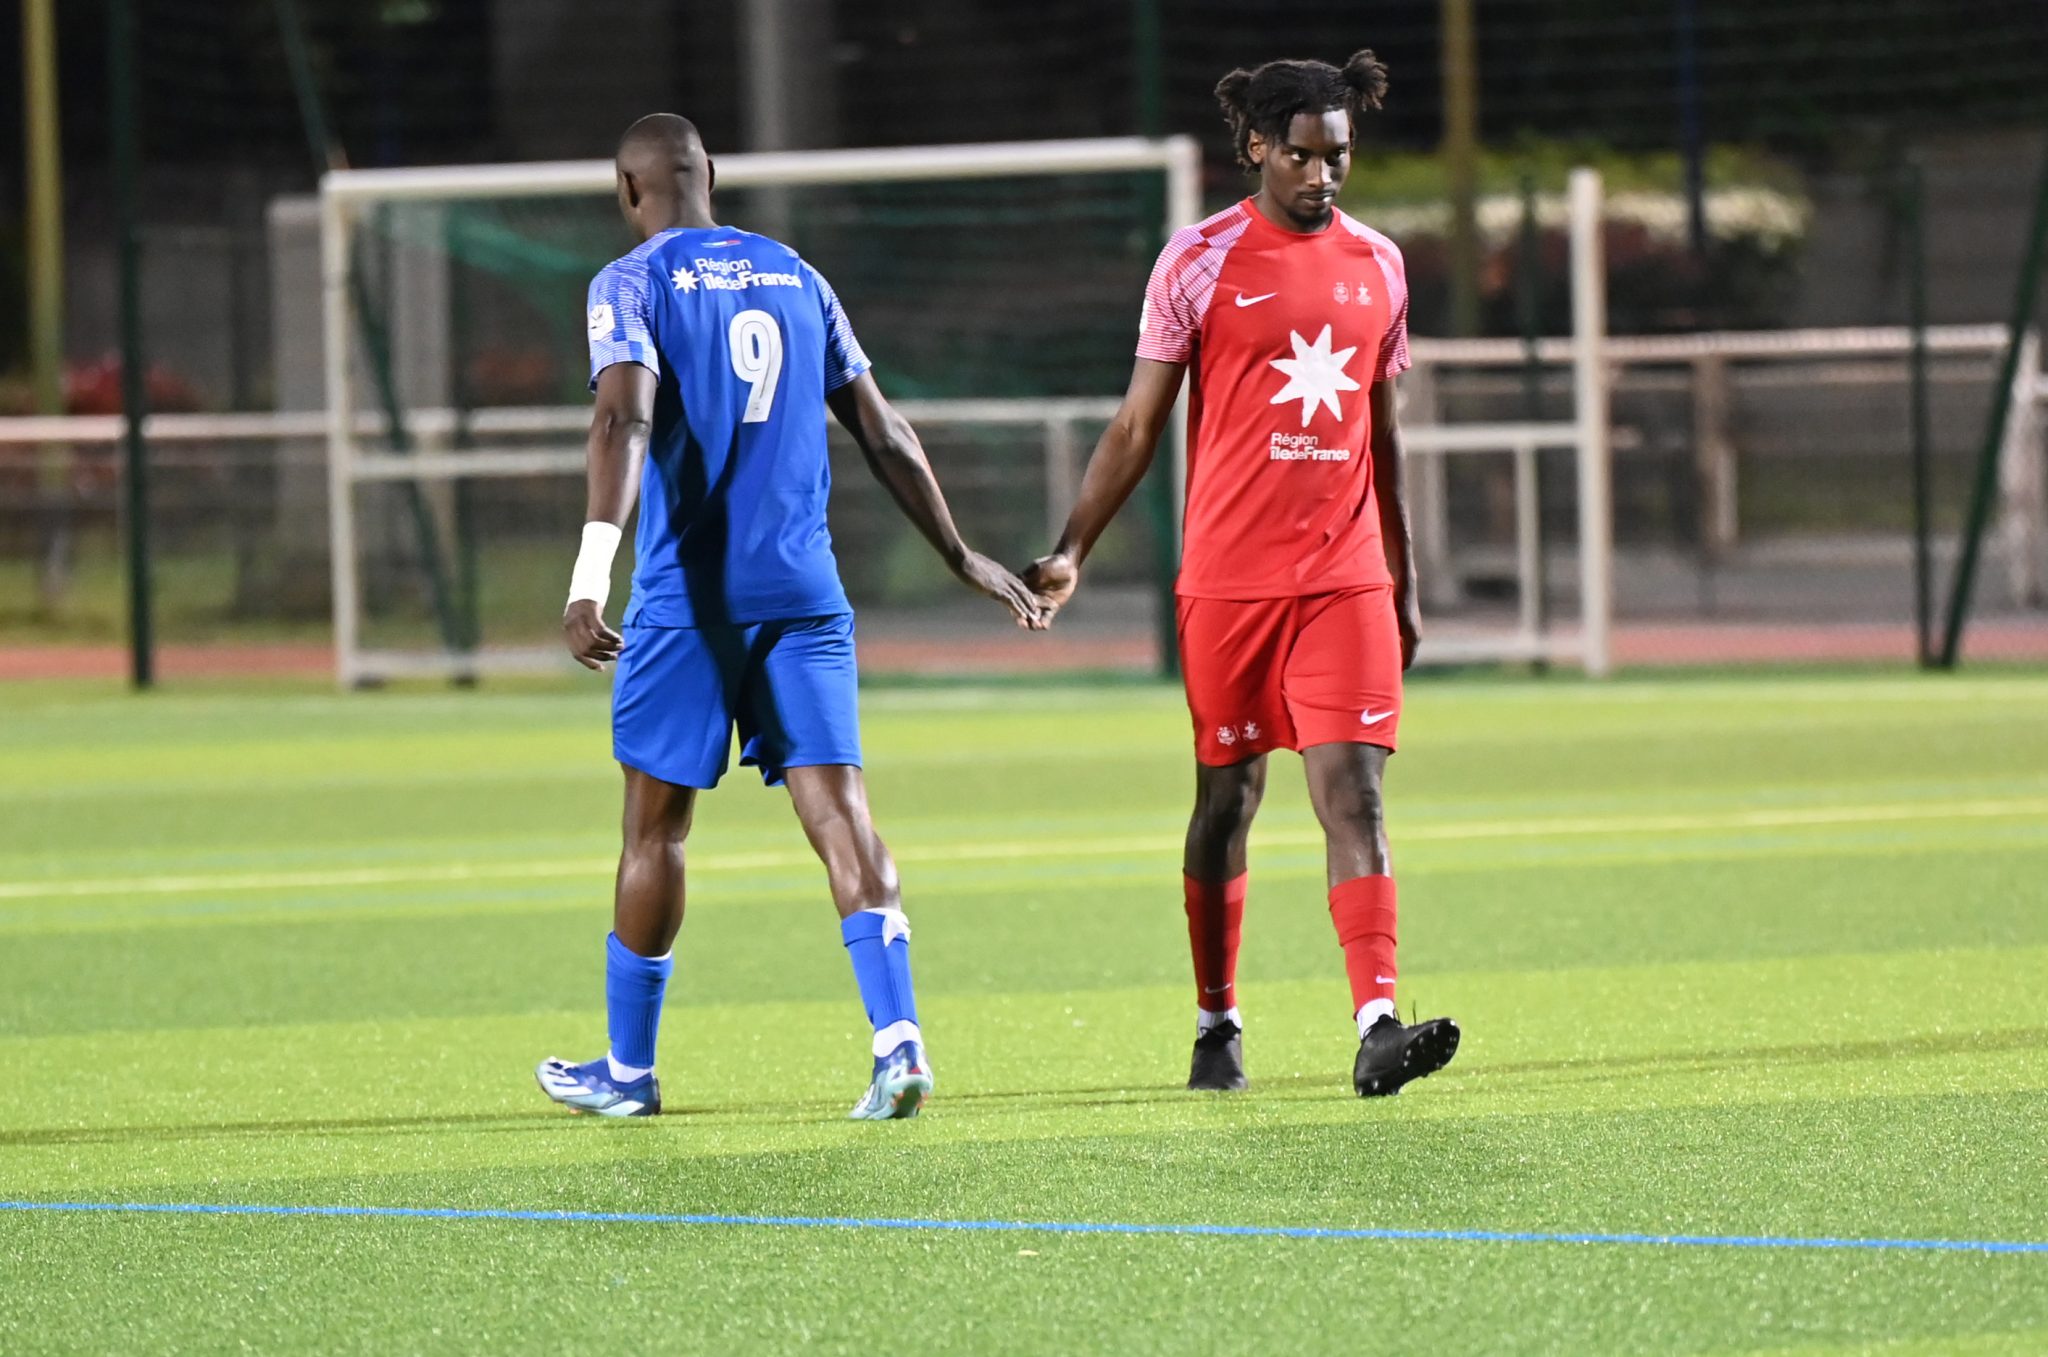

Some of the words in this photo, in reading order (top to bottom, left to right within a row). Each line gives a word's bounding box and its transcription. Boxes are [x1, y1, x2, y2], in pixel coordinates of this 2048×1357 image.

[694, 258, 752, 276] Région
[729, 309, 783, 423] 9
[1271, 432, 1319, 448] Région
